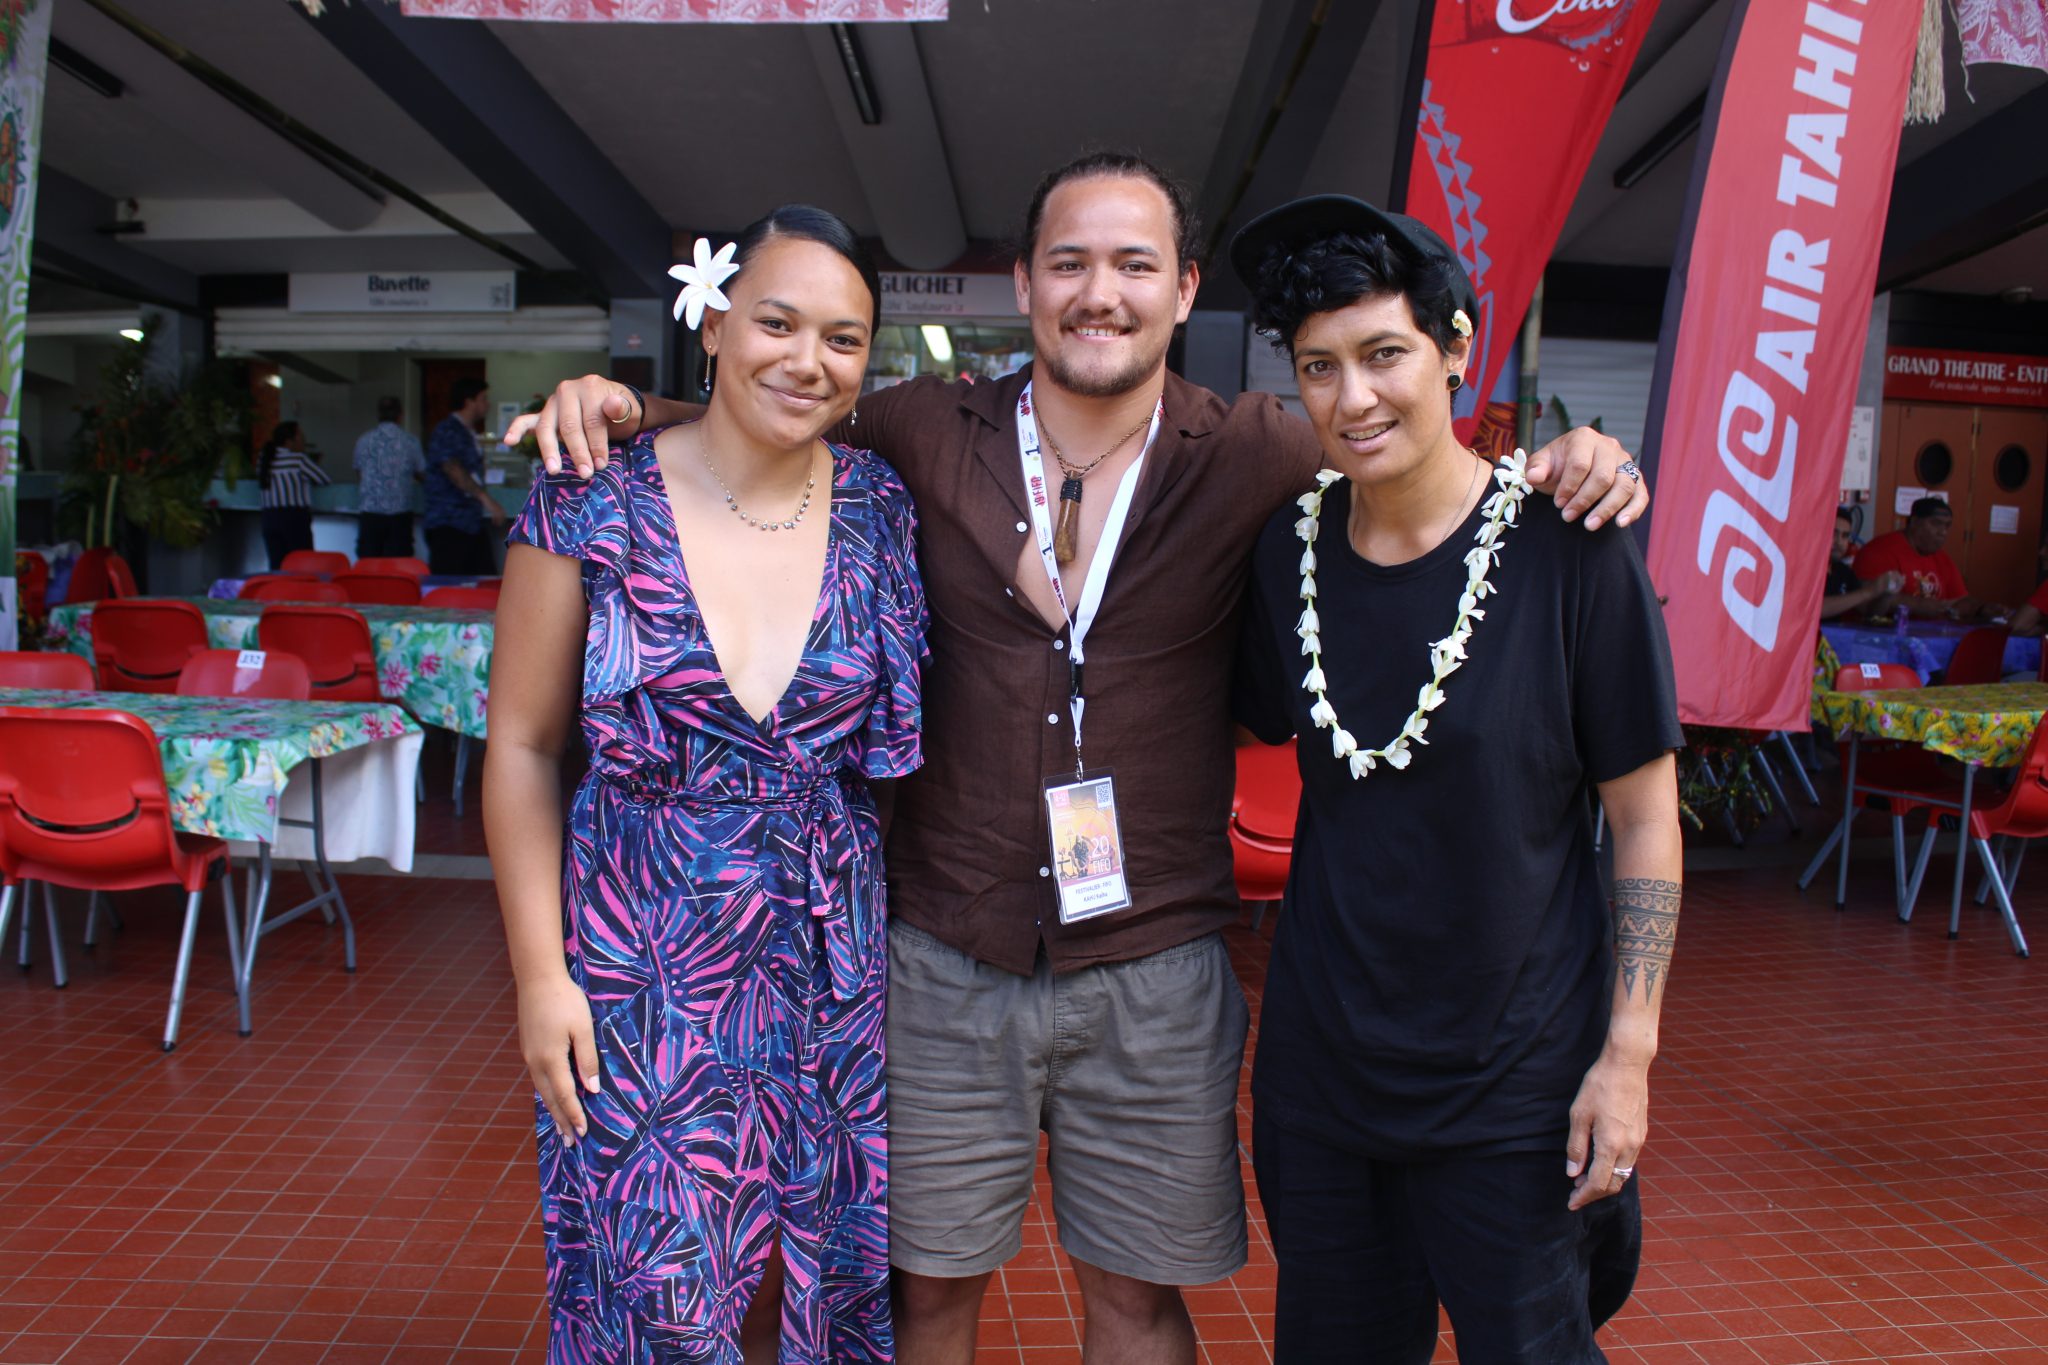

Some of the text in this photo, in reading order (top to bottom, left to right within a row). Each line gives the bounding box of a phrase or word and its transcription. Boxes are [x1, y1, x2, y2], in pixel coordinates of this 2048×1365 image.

[1754, 0, 1868, 395] AIR TAHI
[367, 275, 431, 292] Buvette
[879, 275, 967, 294] GUICHET
[1887, 355, 1940, 376] GRAND
[1944, 359, 2007, 381] THEATRE
[1091, 835, 1110, 858] 20
[1092, 859, 1112, 875] FIFO
